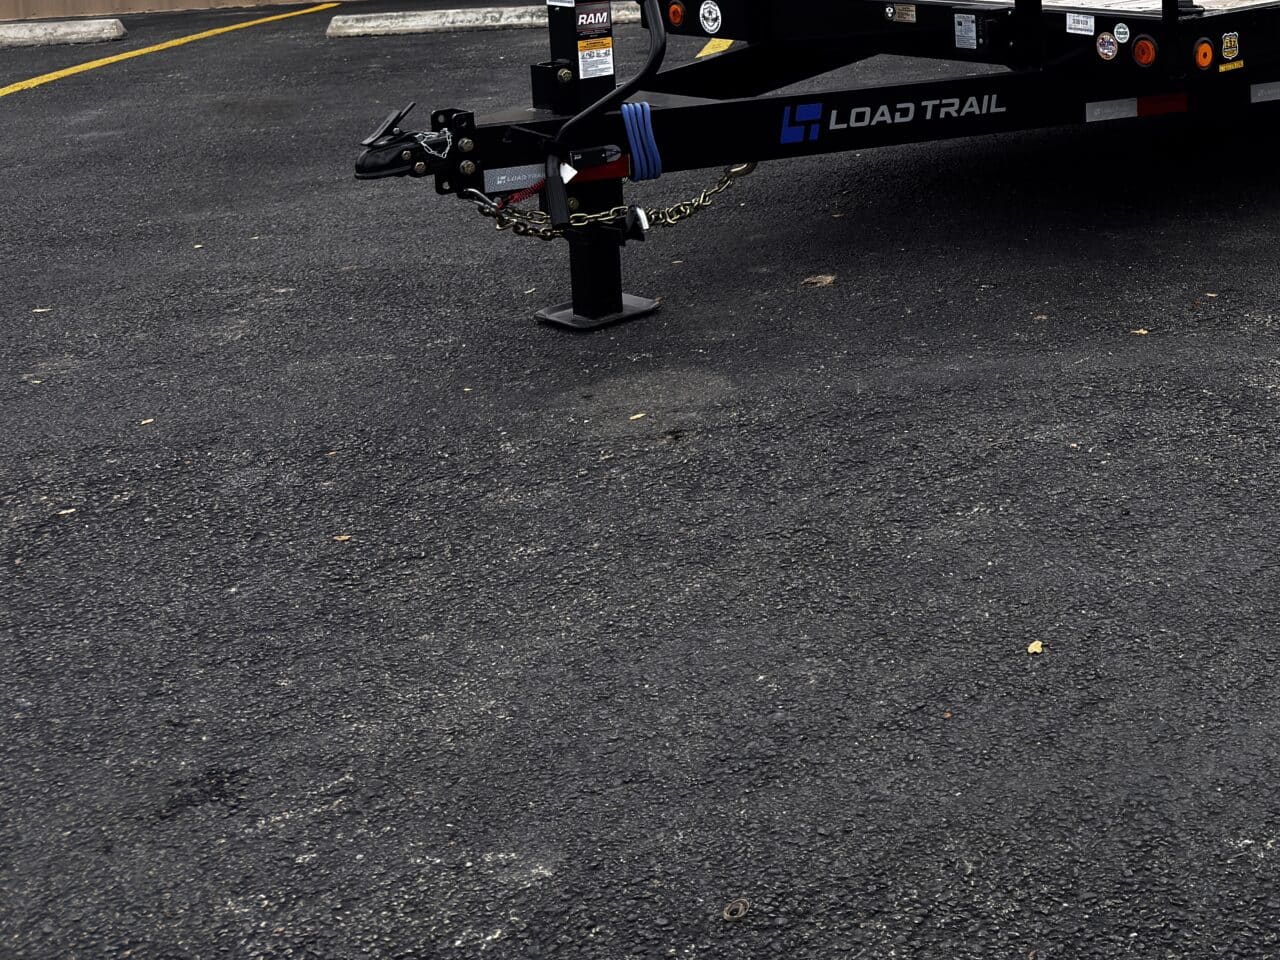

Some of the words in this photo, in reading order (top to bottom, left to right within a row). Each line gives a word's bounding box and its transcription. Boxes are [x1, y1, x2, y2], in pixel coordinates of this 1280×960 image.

[577, 12, 608, 26] RAM
[829, 102, 915, 130] LOAD
[922, 94, 1006, 120] TRAIL
